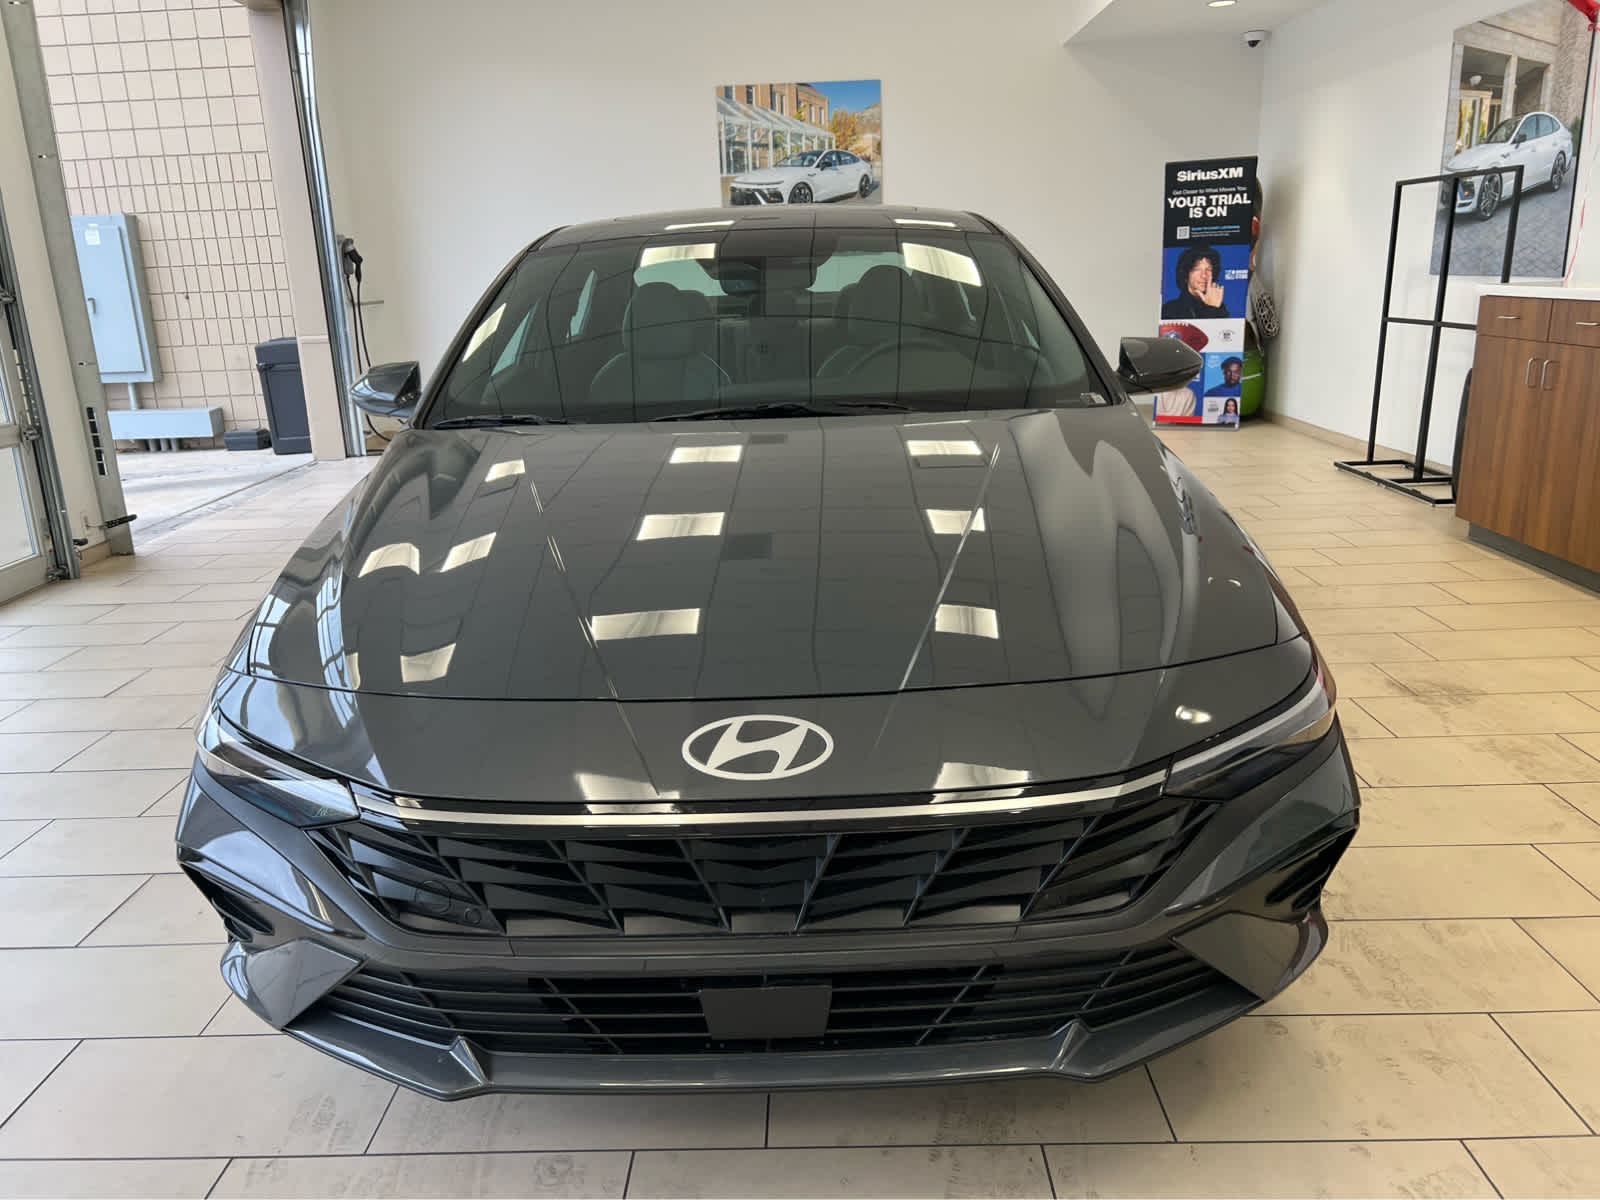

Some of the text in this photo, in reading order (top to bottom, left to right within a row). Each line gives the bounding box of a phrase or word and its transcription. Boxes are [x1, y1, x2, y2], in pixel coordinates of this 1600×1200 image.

[1177, 167, 1243, 182] SiriusXM
[1168, 193, 1251, 208] YOUR TRIAL
[1189, 206, 1227, 218] IS ON
